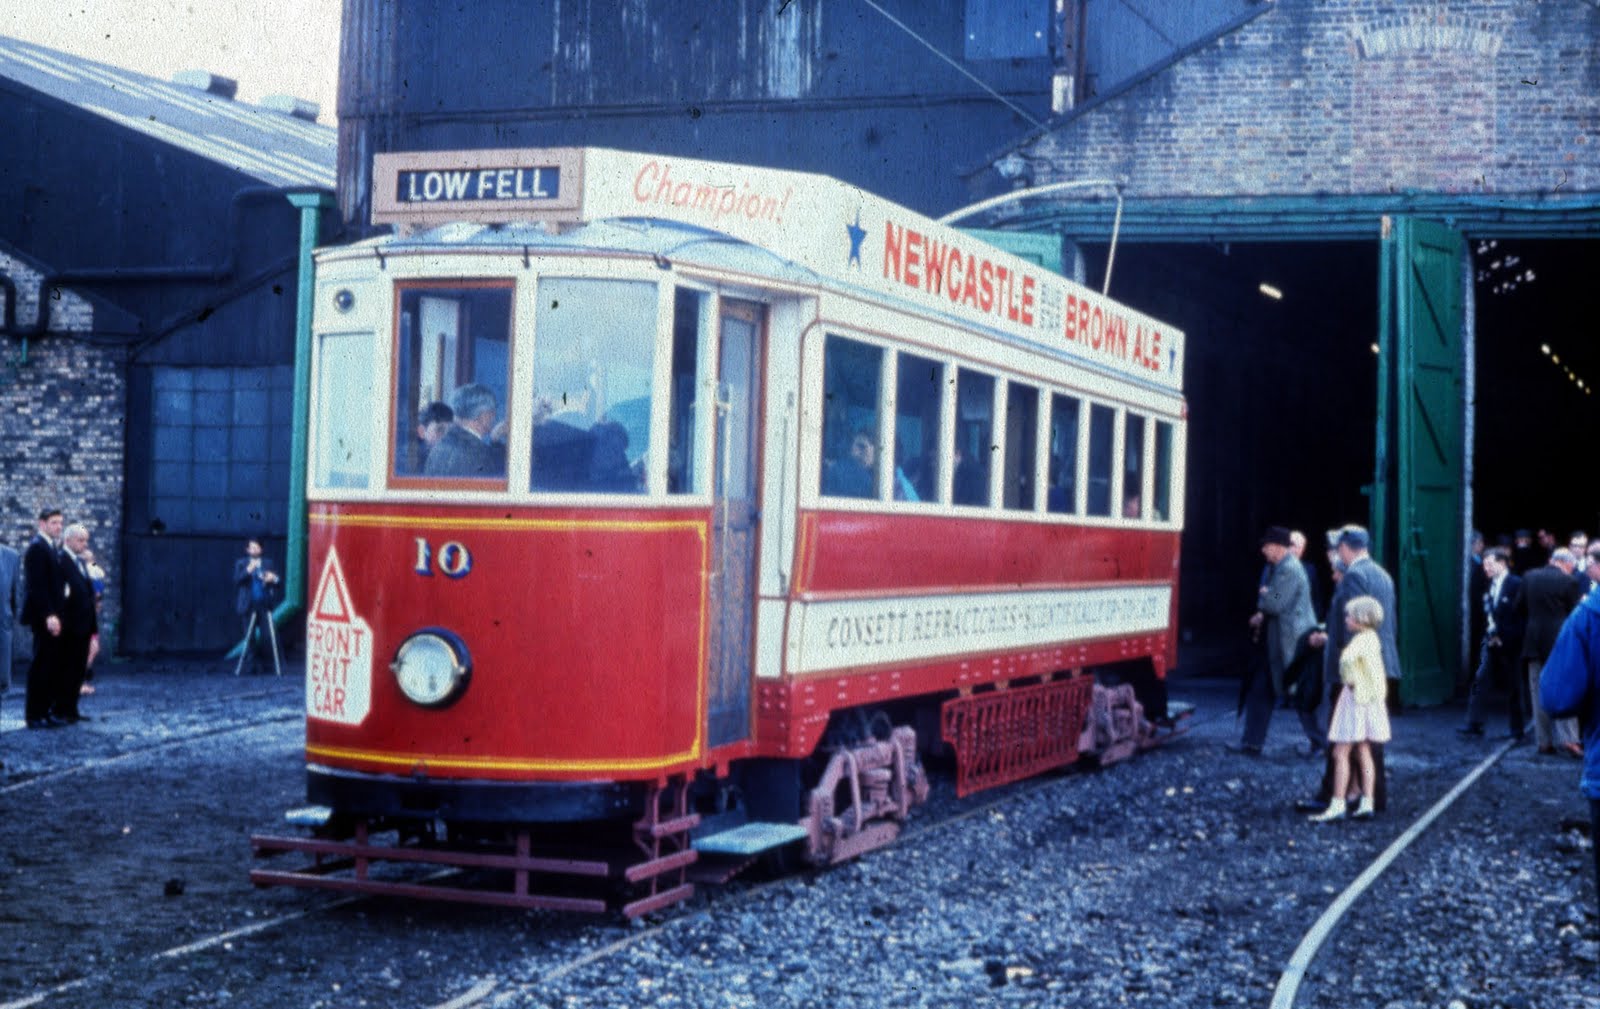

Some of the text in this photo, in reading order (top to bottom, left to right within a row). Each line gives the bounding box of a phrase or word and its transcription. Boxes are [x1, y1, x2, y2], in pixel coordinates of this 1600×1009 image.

[409, 168, 548, 201] LOW FELL
[633, 160, 794, 225] Champion!
[883, 220, 1035, 327] NEWCASTLE
[1064, 293, 1129, 361] BROWN
[1133, 323, 1162, 372] ALE
[415, 537, 474, 579] 10
[308, 621, 365, 657] FRONT
[828, 610, 908, 649] CONSETT
[312, 653, 350, 687] EXIT
[313, 684, 347, 717] CAR
